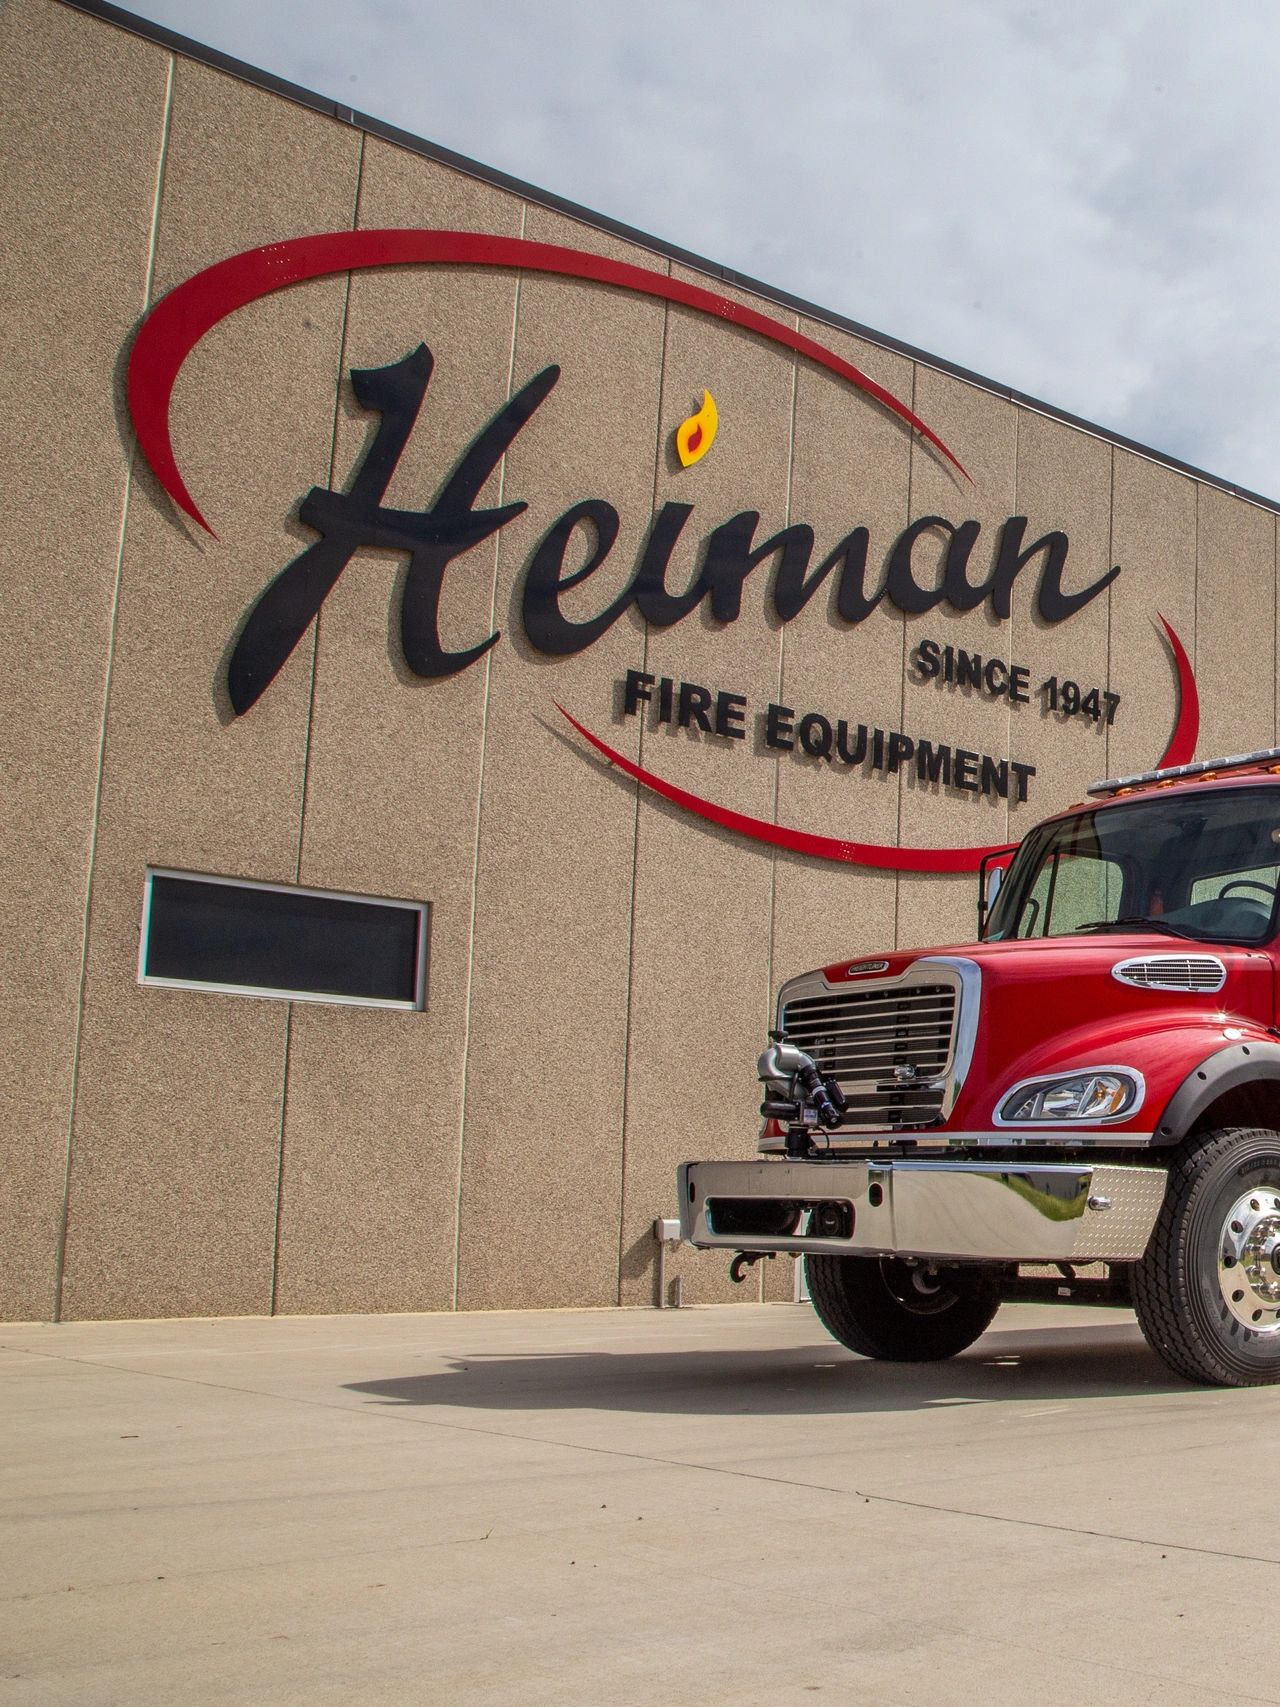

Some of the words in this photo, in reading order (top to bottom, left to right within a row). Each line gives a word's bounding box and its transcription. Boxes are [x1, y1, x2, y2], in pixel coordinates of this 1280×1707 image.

[228, 341, 1122, 717] Heiman
[624, 669, 747, 740] FIRE
[766, 702, 1037, 803] EQUIPMENT
[917, 639, 1030, 703] SINCE
[1043, 676, 1121, 726] 1947
